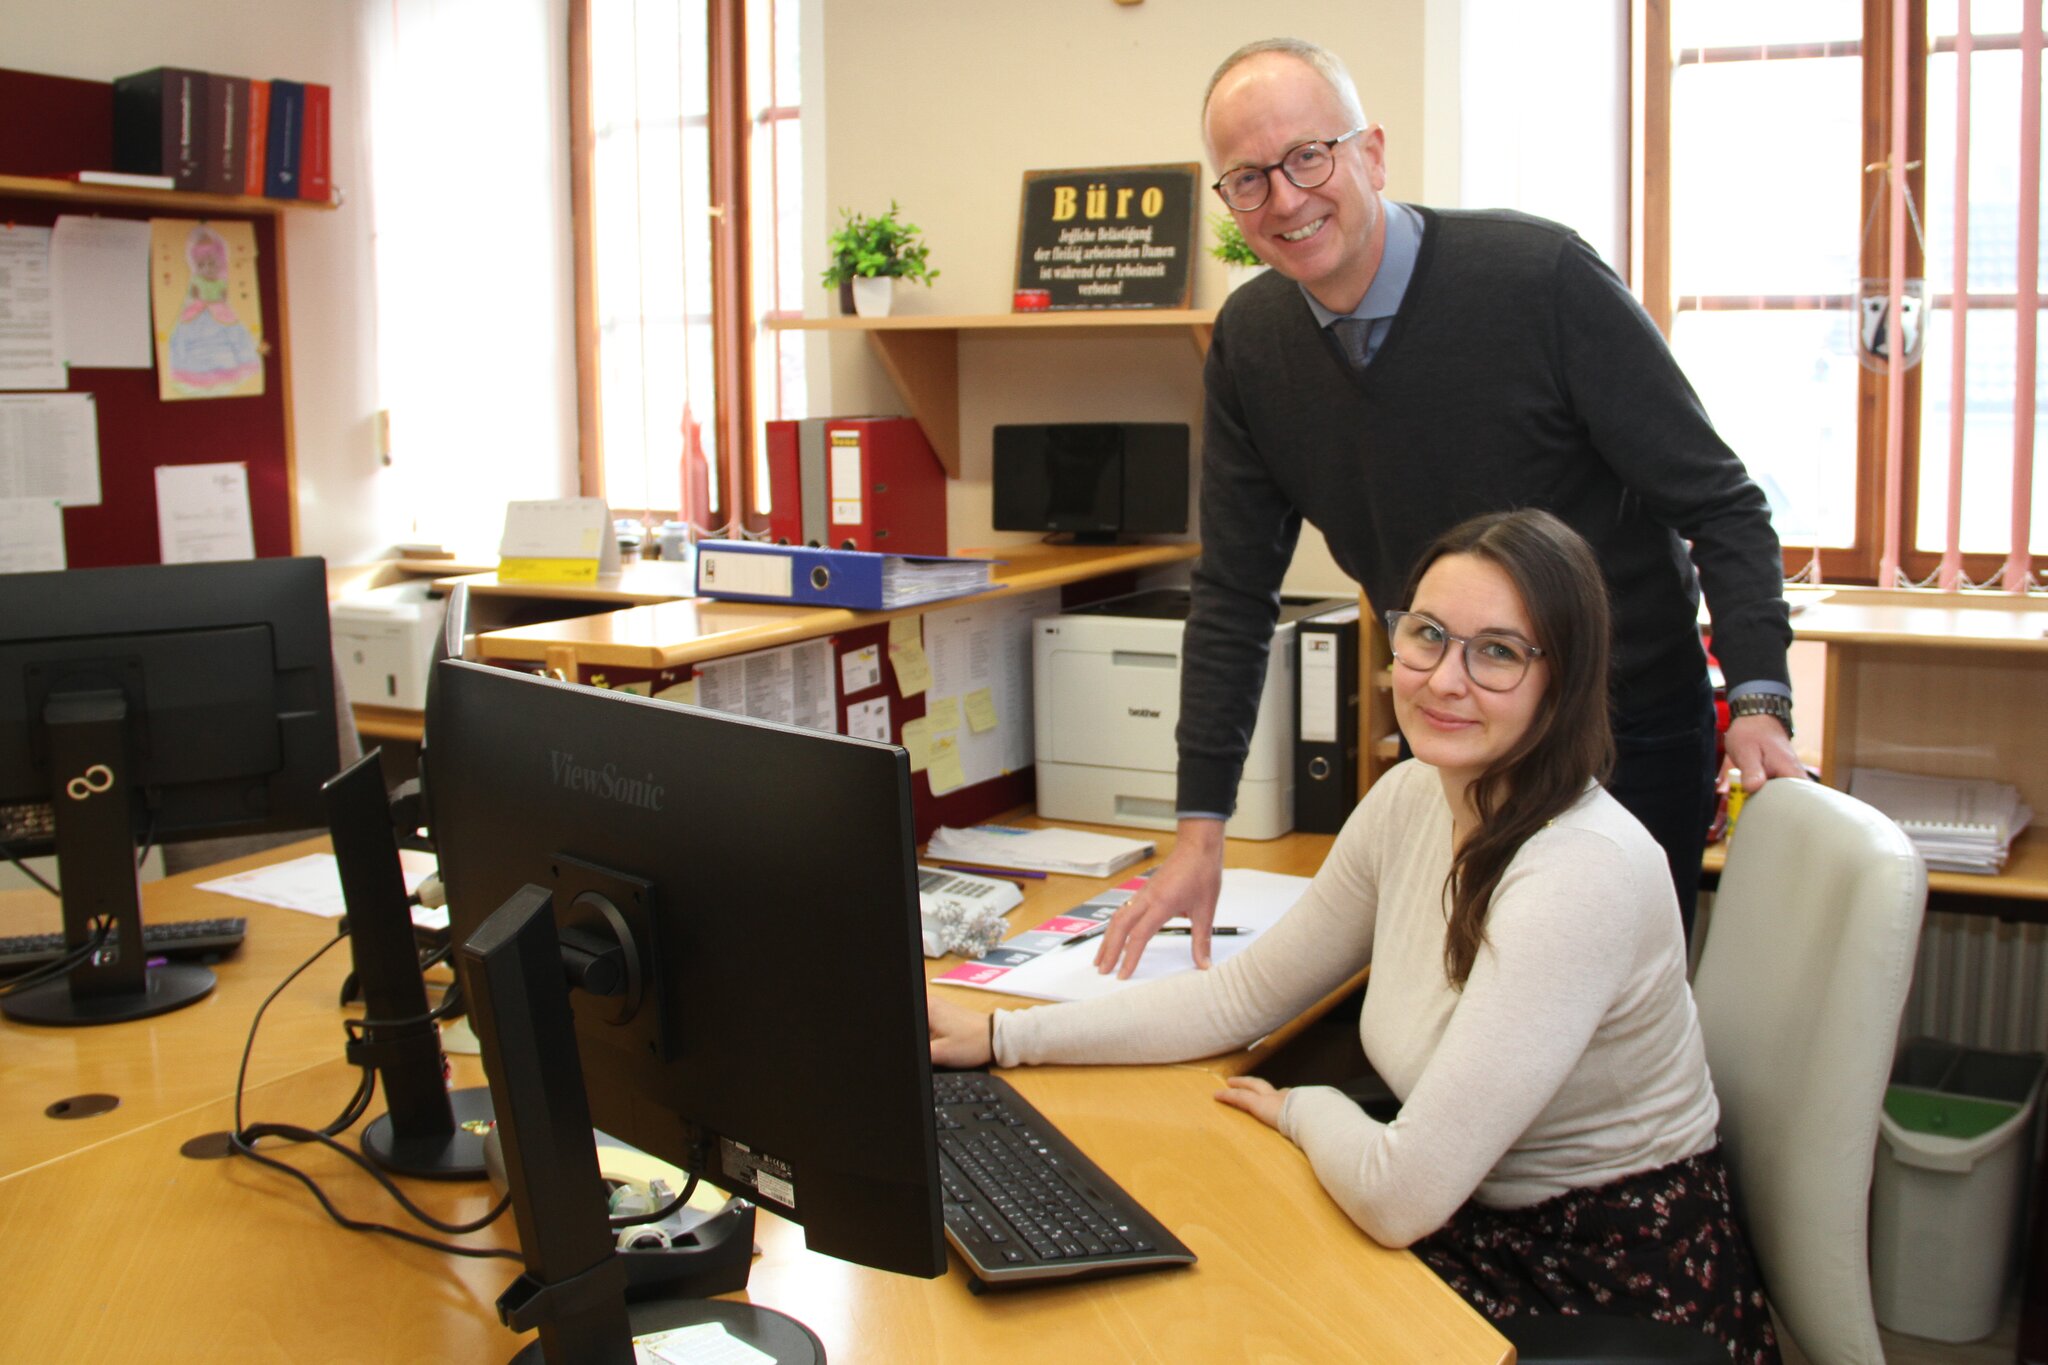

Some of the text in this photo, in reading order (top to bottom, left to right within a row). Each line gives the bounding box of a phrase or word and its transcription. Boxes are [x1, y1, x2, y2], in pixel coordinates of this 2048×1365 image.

[1052, 183, 1163, 221] Büro
[1059, 228, 1096, 244] Jegliche
[1034, 247, 1051, 262] der
[1083, 245, 1140, 260] arbeitenden
[1142, 244, 1175, 258] Damen
[1040, 262, 1166, 280] ist während der Arbeitszeit
[1128, 707, 1160, 719] brother
[551, 750, 665, 811] ViewSonic
